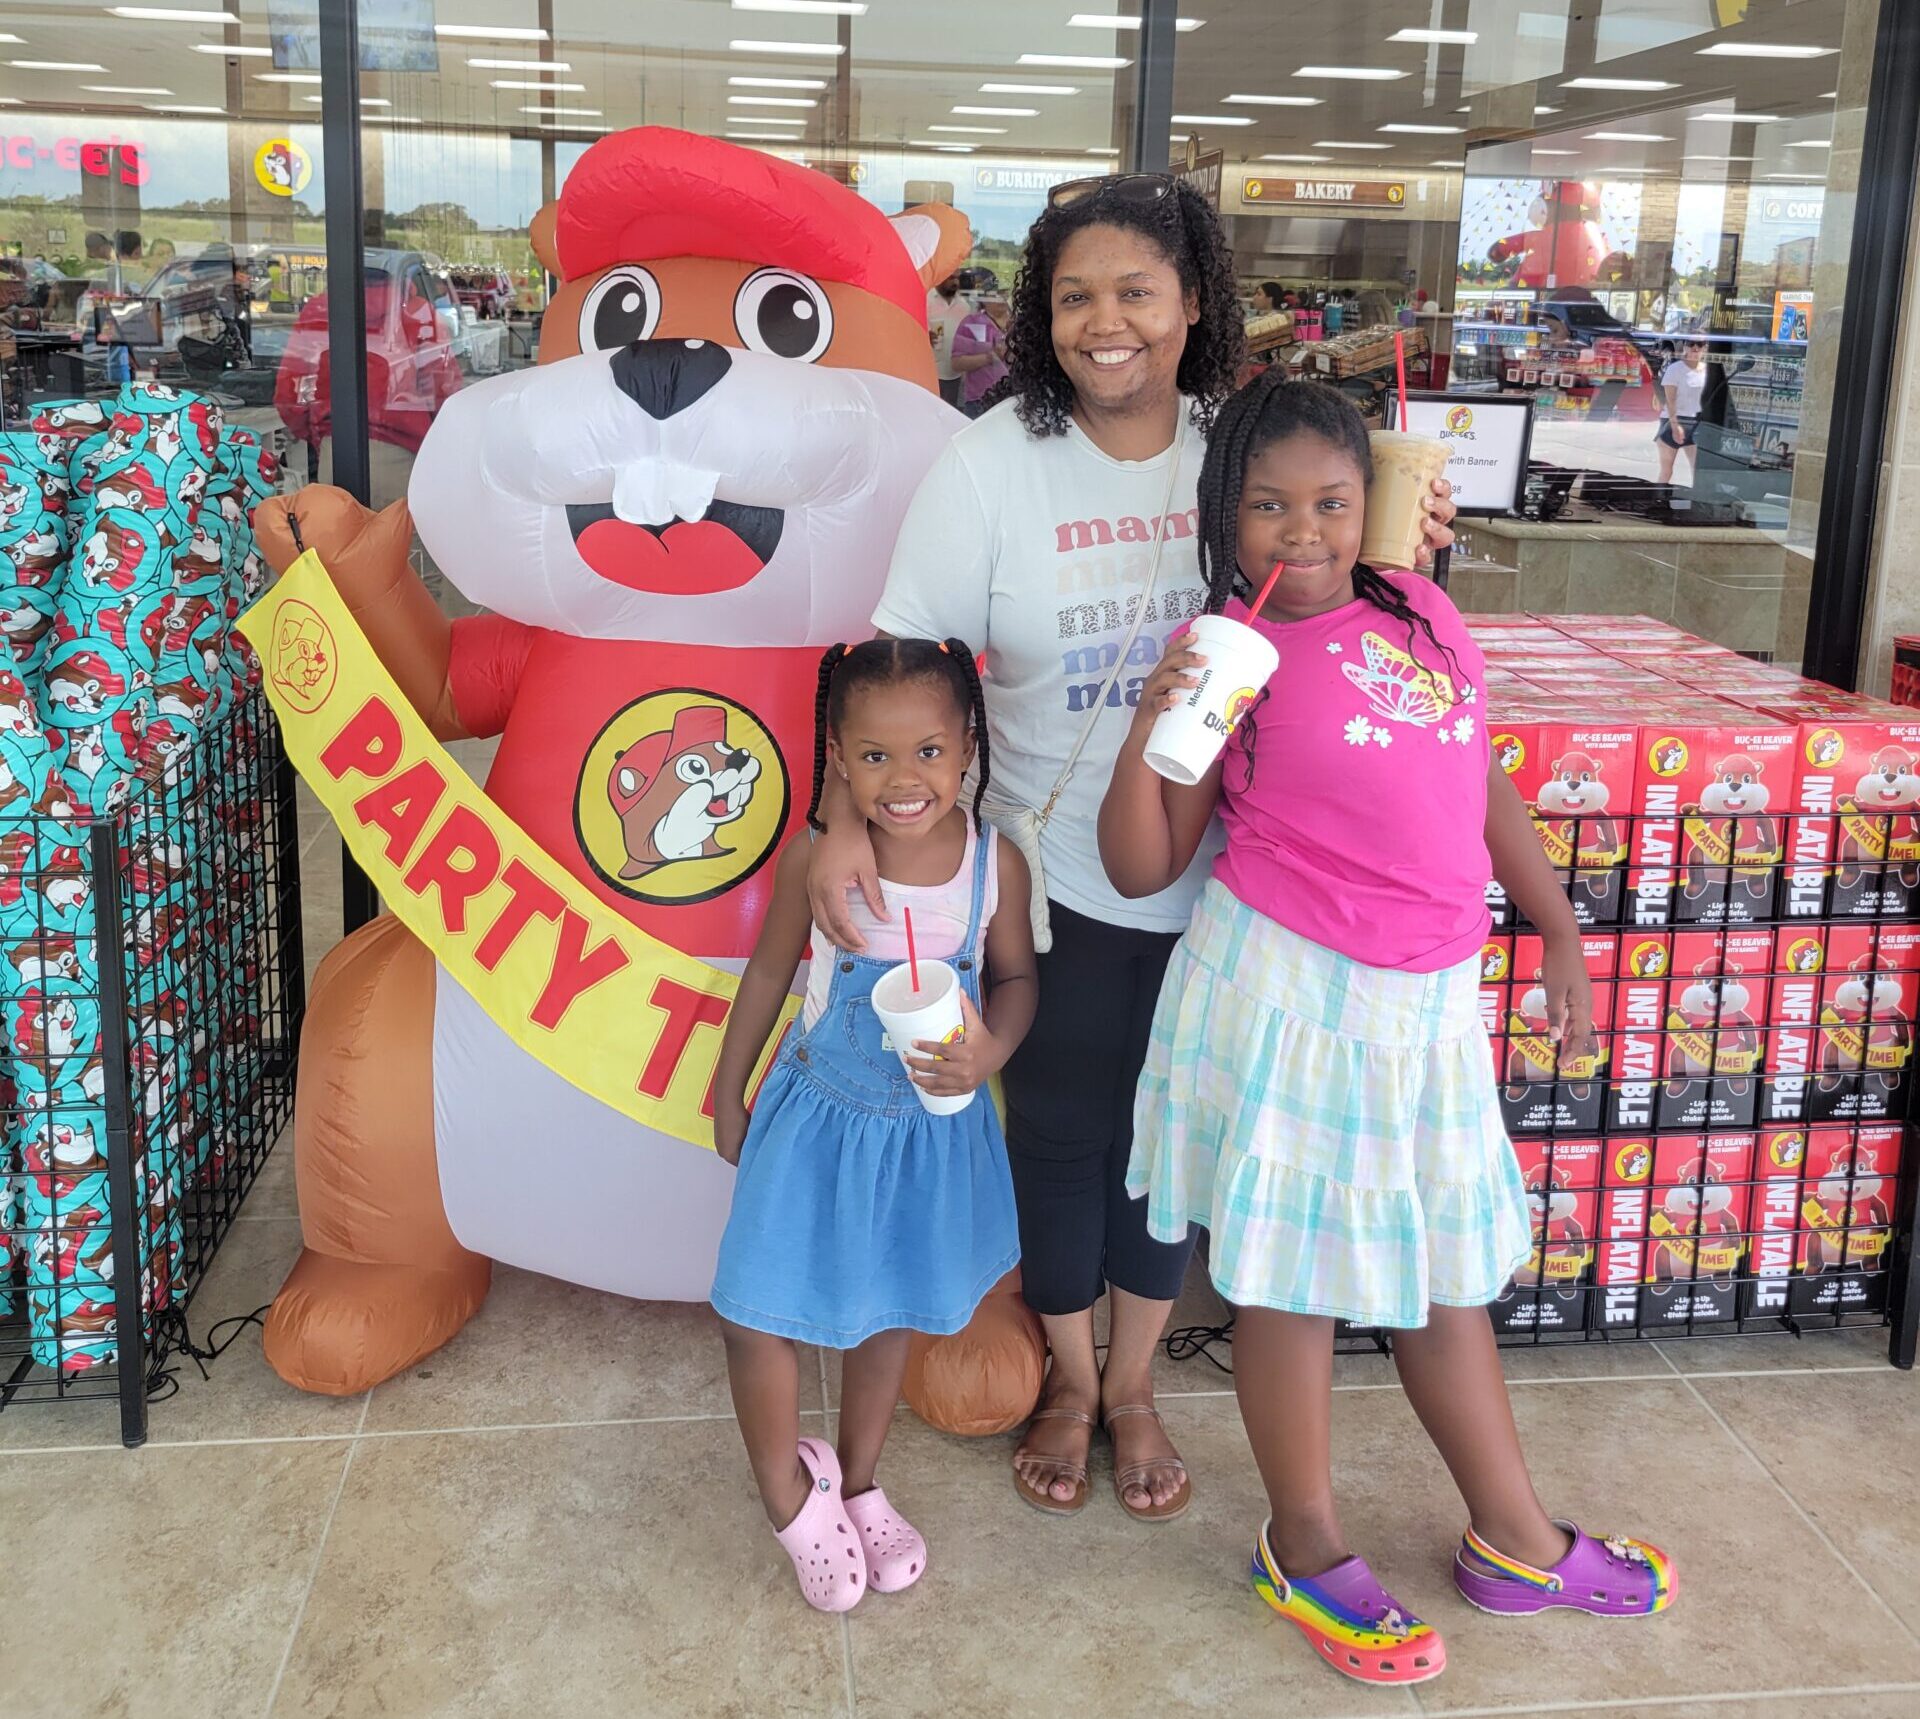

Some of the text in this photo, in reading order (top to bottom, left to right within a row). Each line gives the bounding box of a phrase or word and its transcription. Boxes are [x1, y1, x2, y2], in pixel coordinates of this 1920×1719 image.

[0, 134, 152, 187] C-EE'S
[1294, 182, 1356, 200] BAKERY
[1787, 202, 1823, 218] COFF
[1448, 457, 1498, 467] with Banner
[1055, 507, 1199, 552] mam
[1056, 551, 1199, 596] mam
[1057, 587, 1208, 640] mam
[1061, 634, 1168, 675] ma
[1066, 676, 1148, 712] ma
[1187, 669, 1213, 707] Medium
[1572, 733, 1632, 742] BUC-EE BEAVER
[1734, 735, 1792, 744] BUC-EE BEAVER
[1696, 828, 1729, 861] PARTY
[1791, 775, 1834, 915] INFLATABLE
[1851, 819, 1883, 851] PARTY
[320, 695, 632, 1033] PARTY
[1636, 784, 1679, 925] INFLATABLE
[1584, 941, 1614, 950] BEAVER
[1742, 938, 1771, 946] BEAVER
[1619, 987, 1659, 1125] INFLATABLE
[1772, 983, 1814, 1118] INFLATABLE
[1557, 1104, 1567, 1112] Up
[1571, 1145, 1600, 1153] BEAVER
[1724, 1137, 1752, 1146] BEAVER
[1605, 1189, 1644, 1322] INFLATABLE
[1757, 1176, 1798, 1307] INFLATABLE
